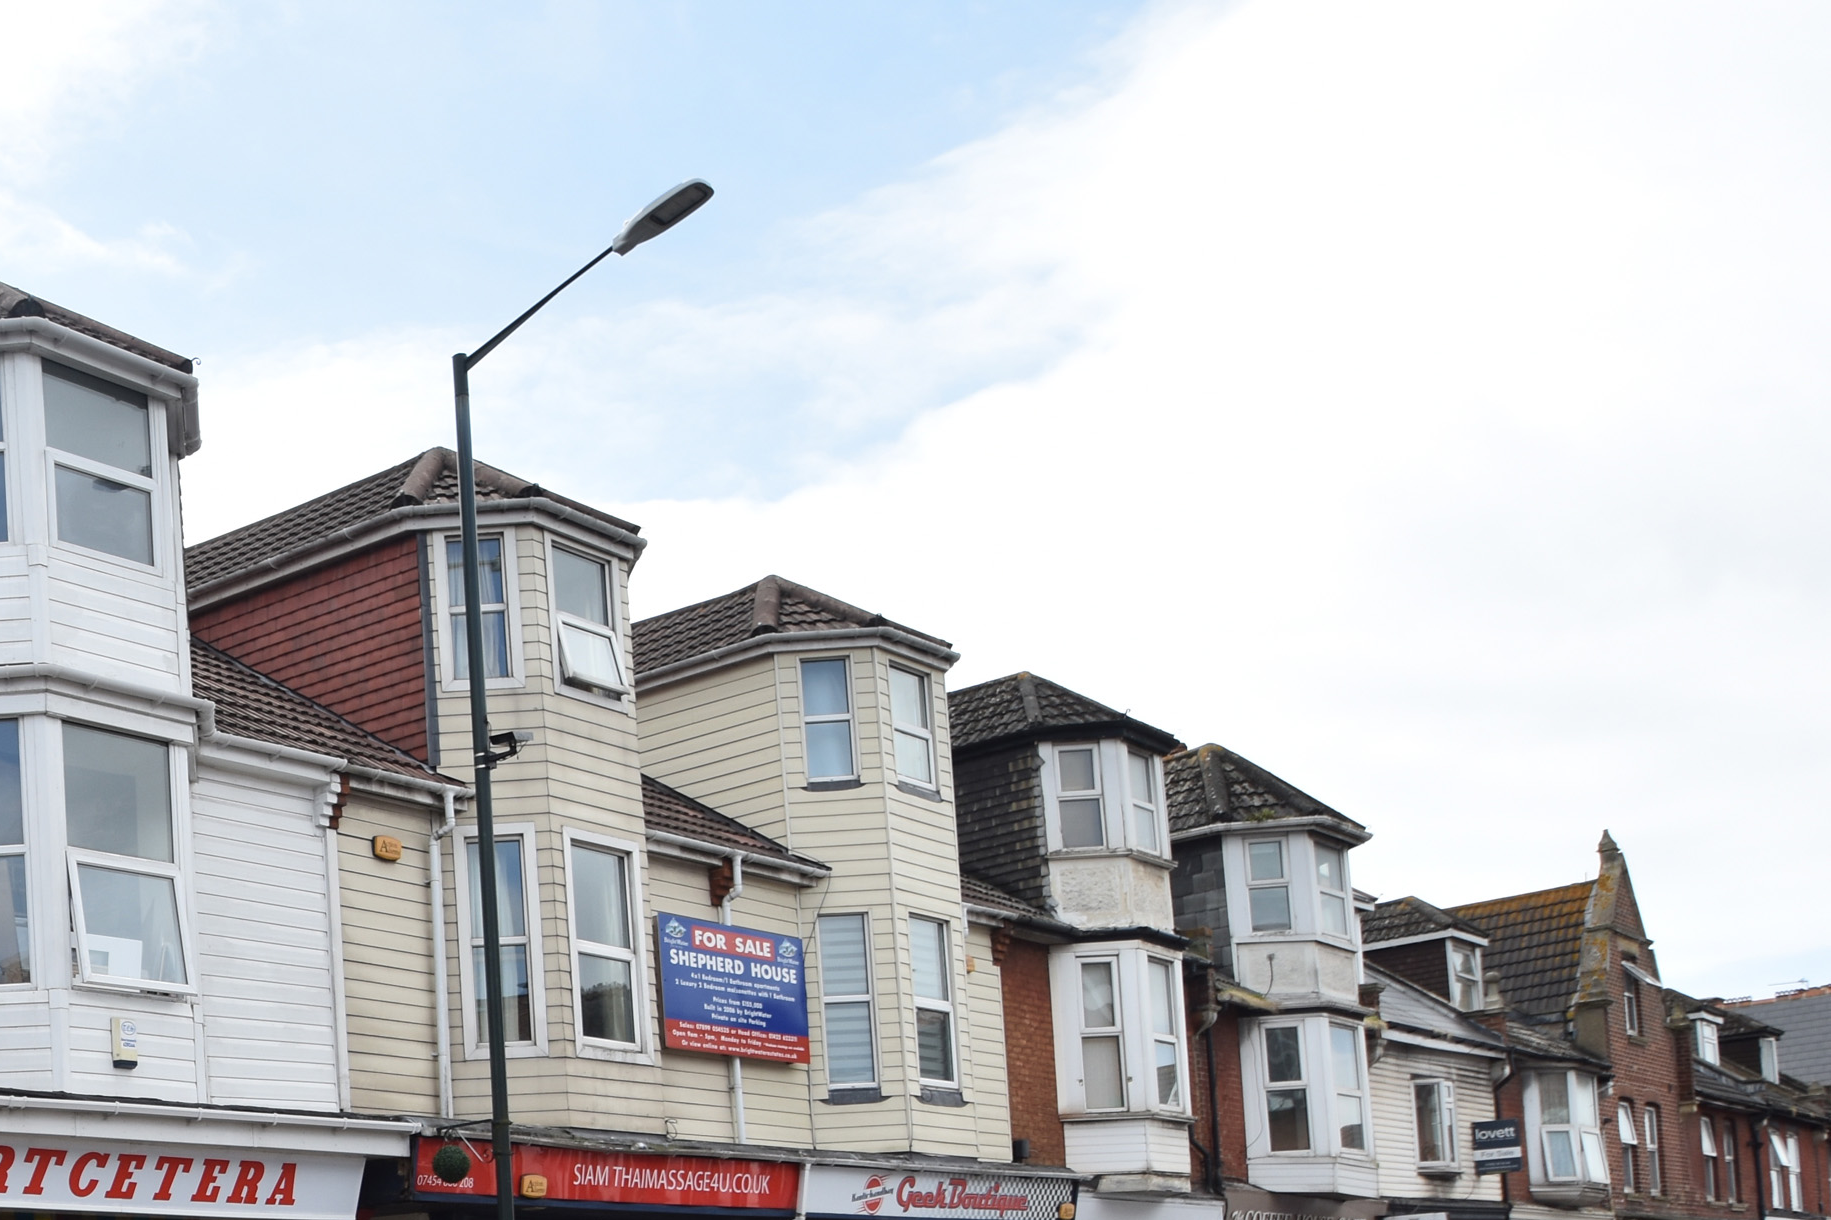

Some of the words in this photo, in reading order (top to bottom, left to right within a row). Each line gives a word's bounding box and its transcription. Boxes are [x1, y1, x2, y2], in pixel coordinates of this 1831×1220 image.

[694, 930, 727, 950] FOR
[735, 937, 772, 957] SALE
[670, 949, 744, 975] SHEPHERD
[751, 962, 798, 984] HOUSE
[680, 979, 697, 989] Luxury
[704, 982, 725, 991] Bedroom
[727, 986, 757, 996] maisonettes
[773, 993, 795, 1002] Bathroom
[730, 978, 752, 987] Bathroom
[754, 983, 780, 991] apartments
[713, 996, 727, 1004] Prices
[729, 998, 740, 1006] from
[712, 1012, 729, 1020] Private
[738, 1016, 747, 1024] site
[749, 1018, 766, 1028] Parking
[737, 1008, 743, 1016] by
[672, 1028, 686, 1036] Open
[721, 1035, 740, 1044] Monday
[748, 1038, 762, 1047] Friday
[702, 1042, 718, 1050] online
[1475, 1127, 1515, 1140] lovett
[573, 1164, 609, 1186] SIAM
[613, 1166, 770, 1194] THAIMASSAGE4U.CO.UK
[896, 1176, 949, 1212] Geek
[949, 1178, 1028, 1217] Boutique
